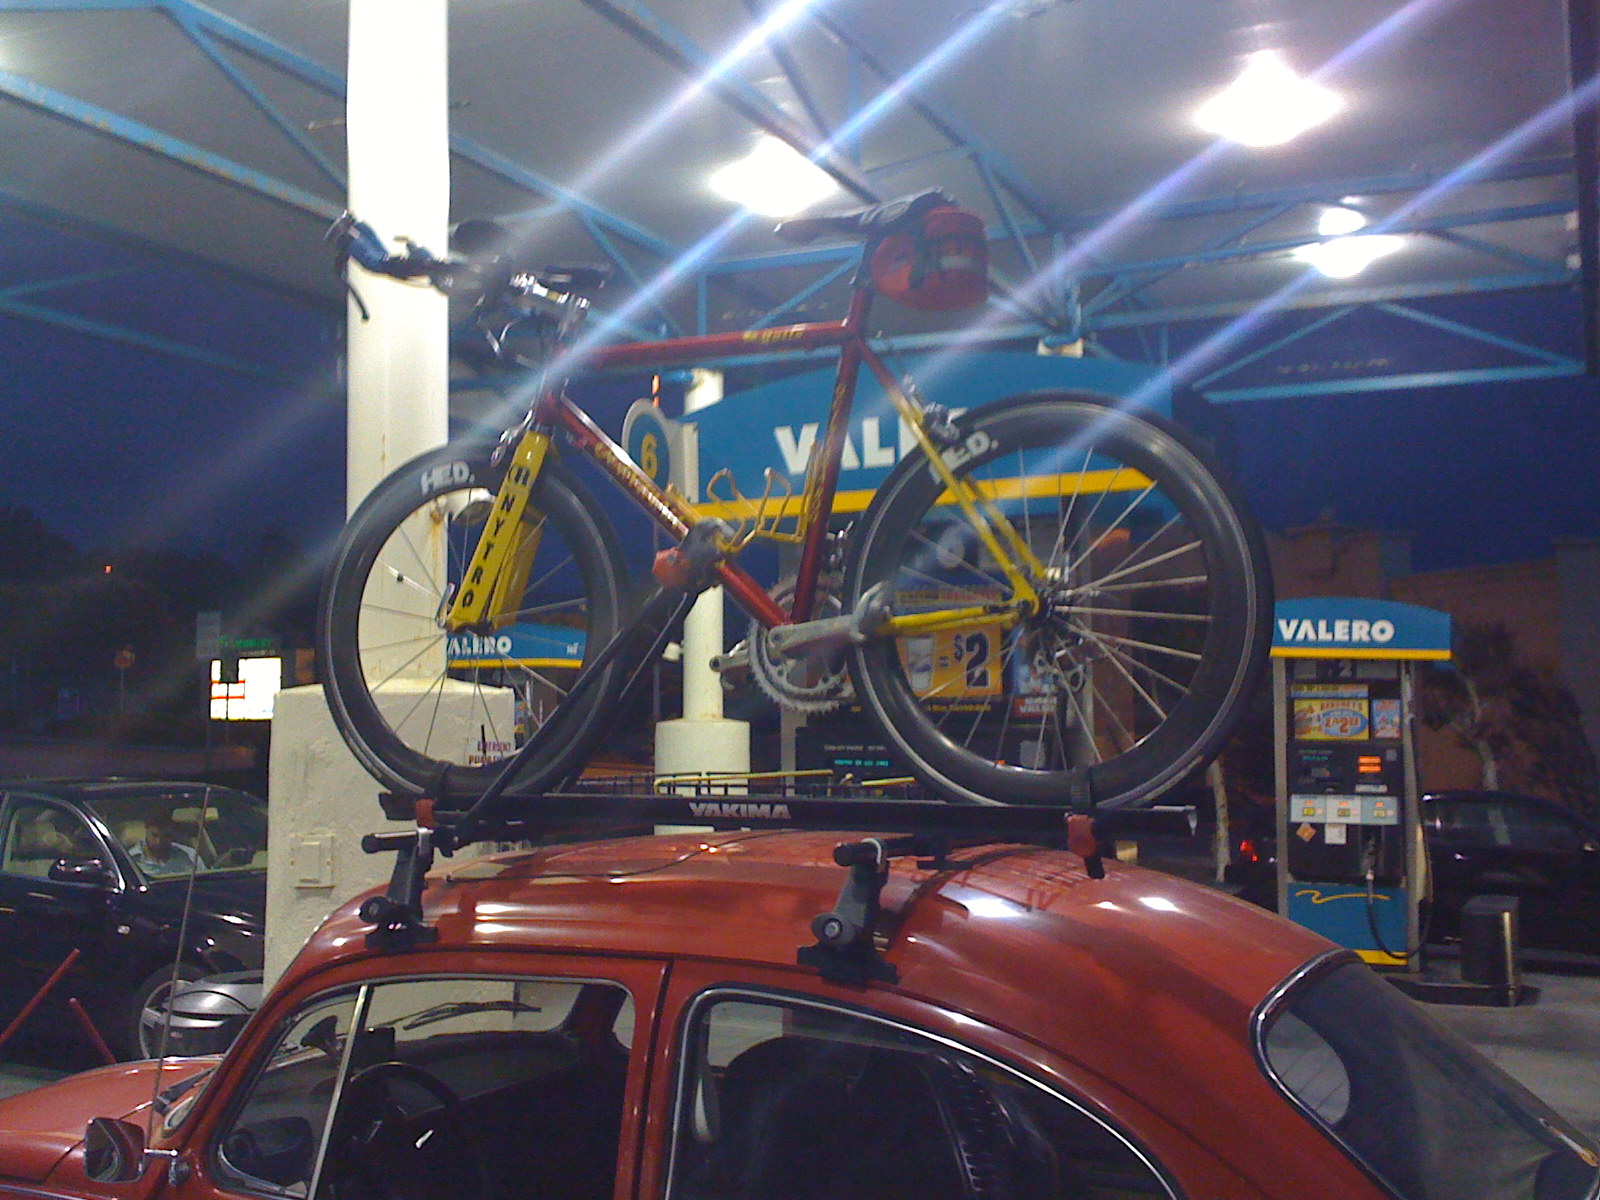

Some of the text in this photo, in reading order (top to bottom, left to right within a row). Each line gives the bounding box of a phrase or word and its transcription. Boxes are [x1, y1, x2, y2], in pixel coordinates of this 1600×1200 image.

[641, 433, 658, 481] 6
[421, 461, 476, 496] HED.
[462, 495, 516, 609] NYTRO
[446, 636, 513, 655] ALERO
[1278, 619, 1396, 643] VALERO
[953, 631, 989, 688] $2
[689, 802, 791, 820] YAKIMA
